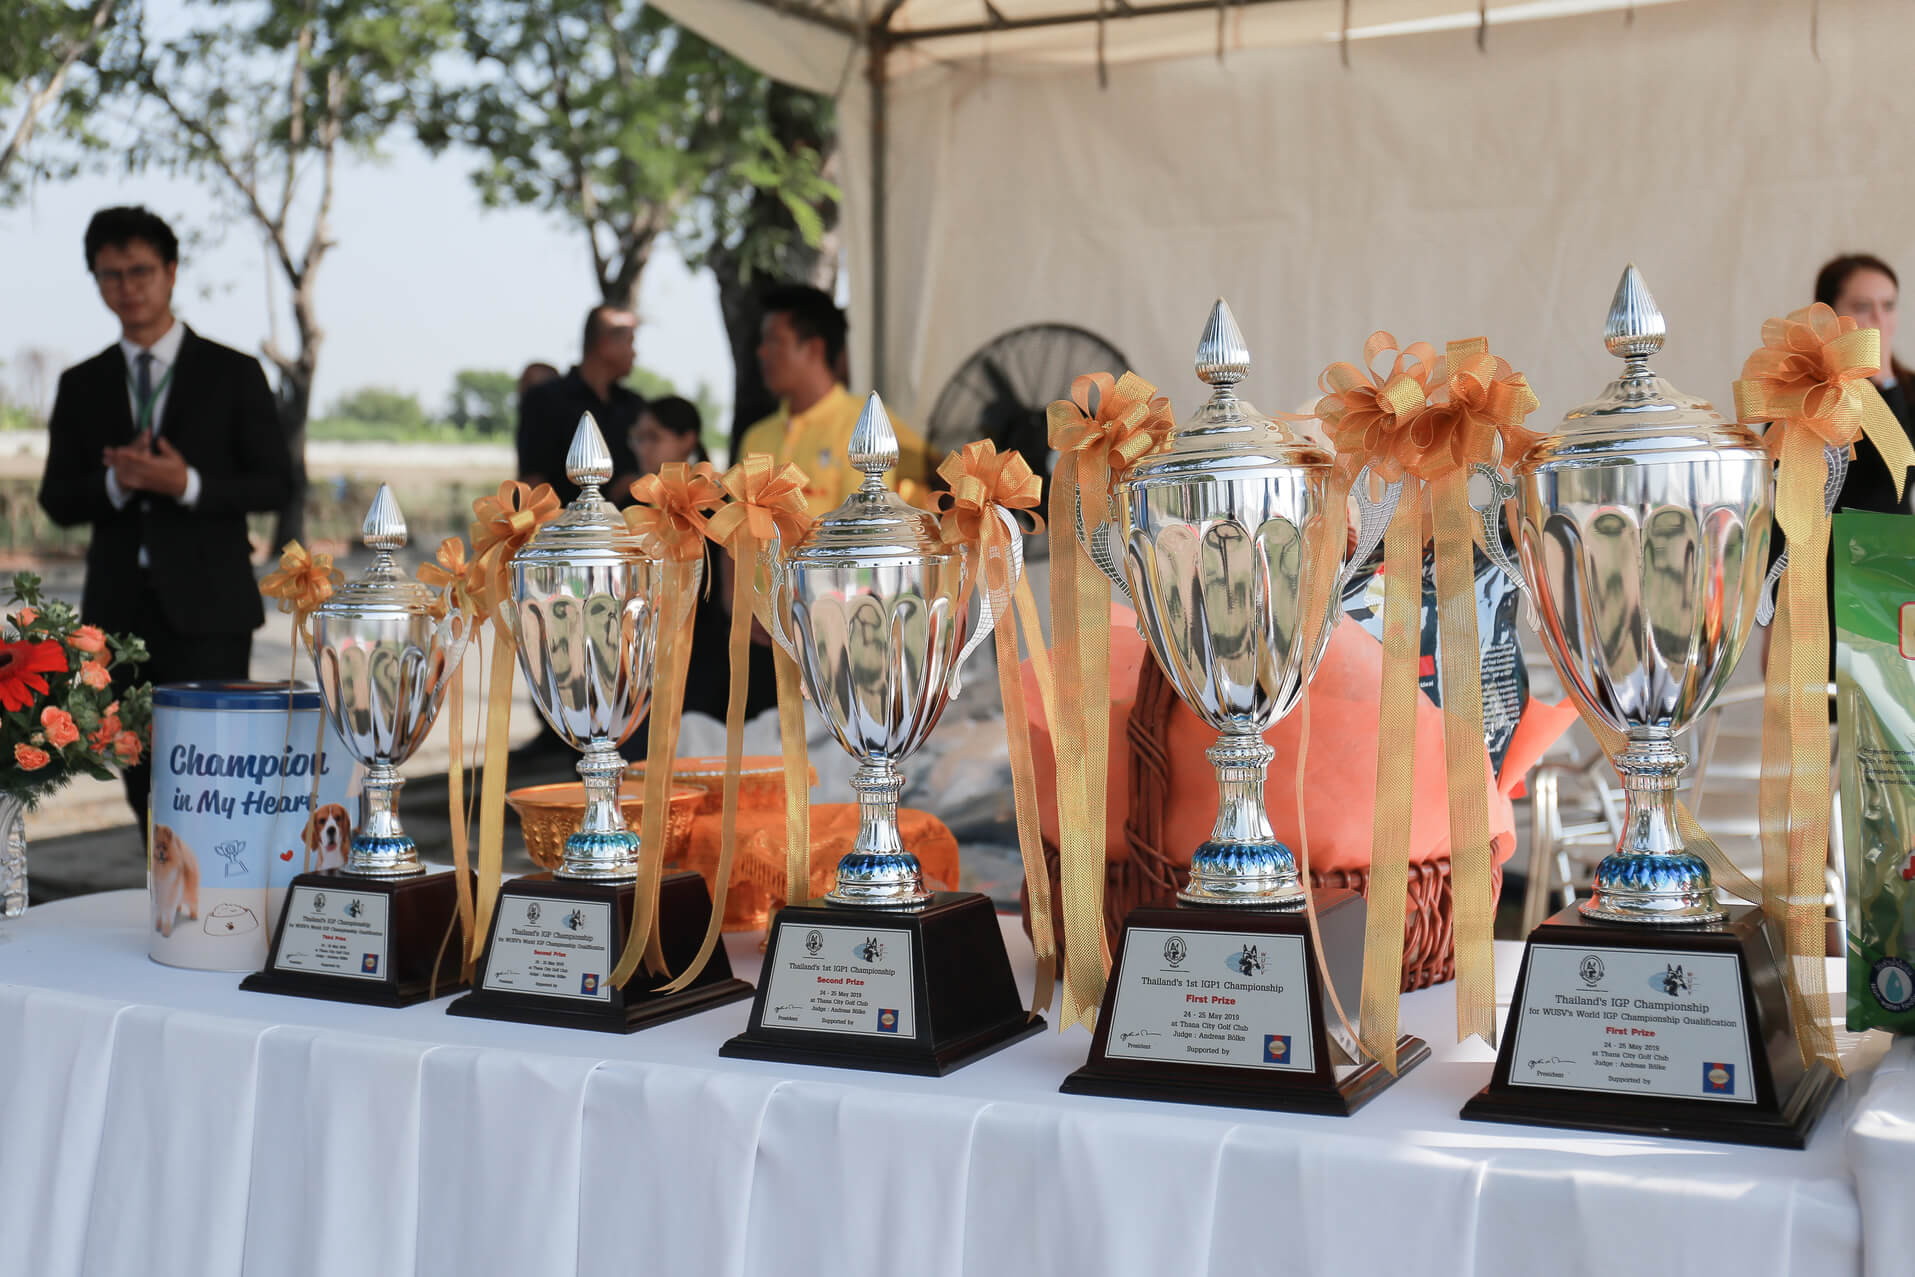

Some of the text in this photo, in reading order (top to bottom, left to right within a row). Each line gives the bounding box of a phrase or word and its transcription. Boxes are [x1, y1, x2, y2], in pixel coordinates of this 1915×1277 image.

[170, 744, 330, 785] Champion
[173, 787, 193, 812] in
[196, 789, 236, 820] My
[790, 963, 820, 971] Thailand's
[850, 966, 895, 976] Championship
[817, 976, 864, 986] Second Prize
[1142, 976, 1183, 987] Thailand's
[1201, 980, 1220, 989] IGP1
[1224, 981, 1284, 994] Championship
[1186, 994, 1236, 1005] First Prize
[1555, 994, 1710, 1014] Thailand's IGP Championship
[1208, 1012, 1222, 1020] May
[1543, 1008, 1573, 1017] WUSV's
[1576, 1010, 1600, 1019] World
[1603, 1011, 1618, 1020] IGP
[1621, 1013, 1680, 1025] Championship
[1683, 1017, 1737, 1028] Qualification
[1202, 1022, 1215, 1030] City
[1606, 1026, 1656, 1037] First Prize
[1199, 1032, 1225, 1040] Andreas
[1186, 1045, 1230, 1055] Supported by
[1654, 1054, 1669, 1062] Club
[1608, 1075, 1640, 1084] Supported
